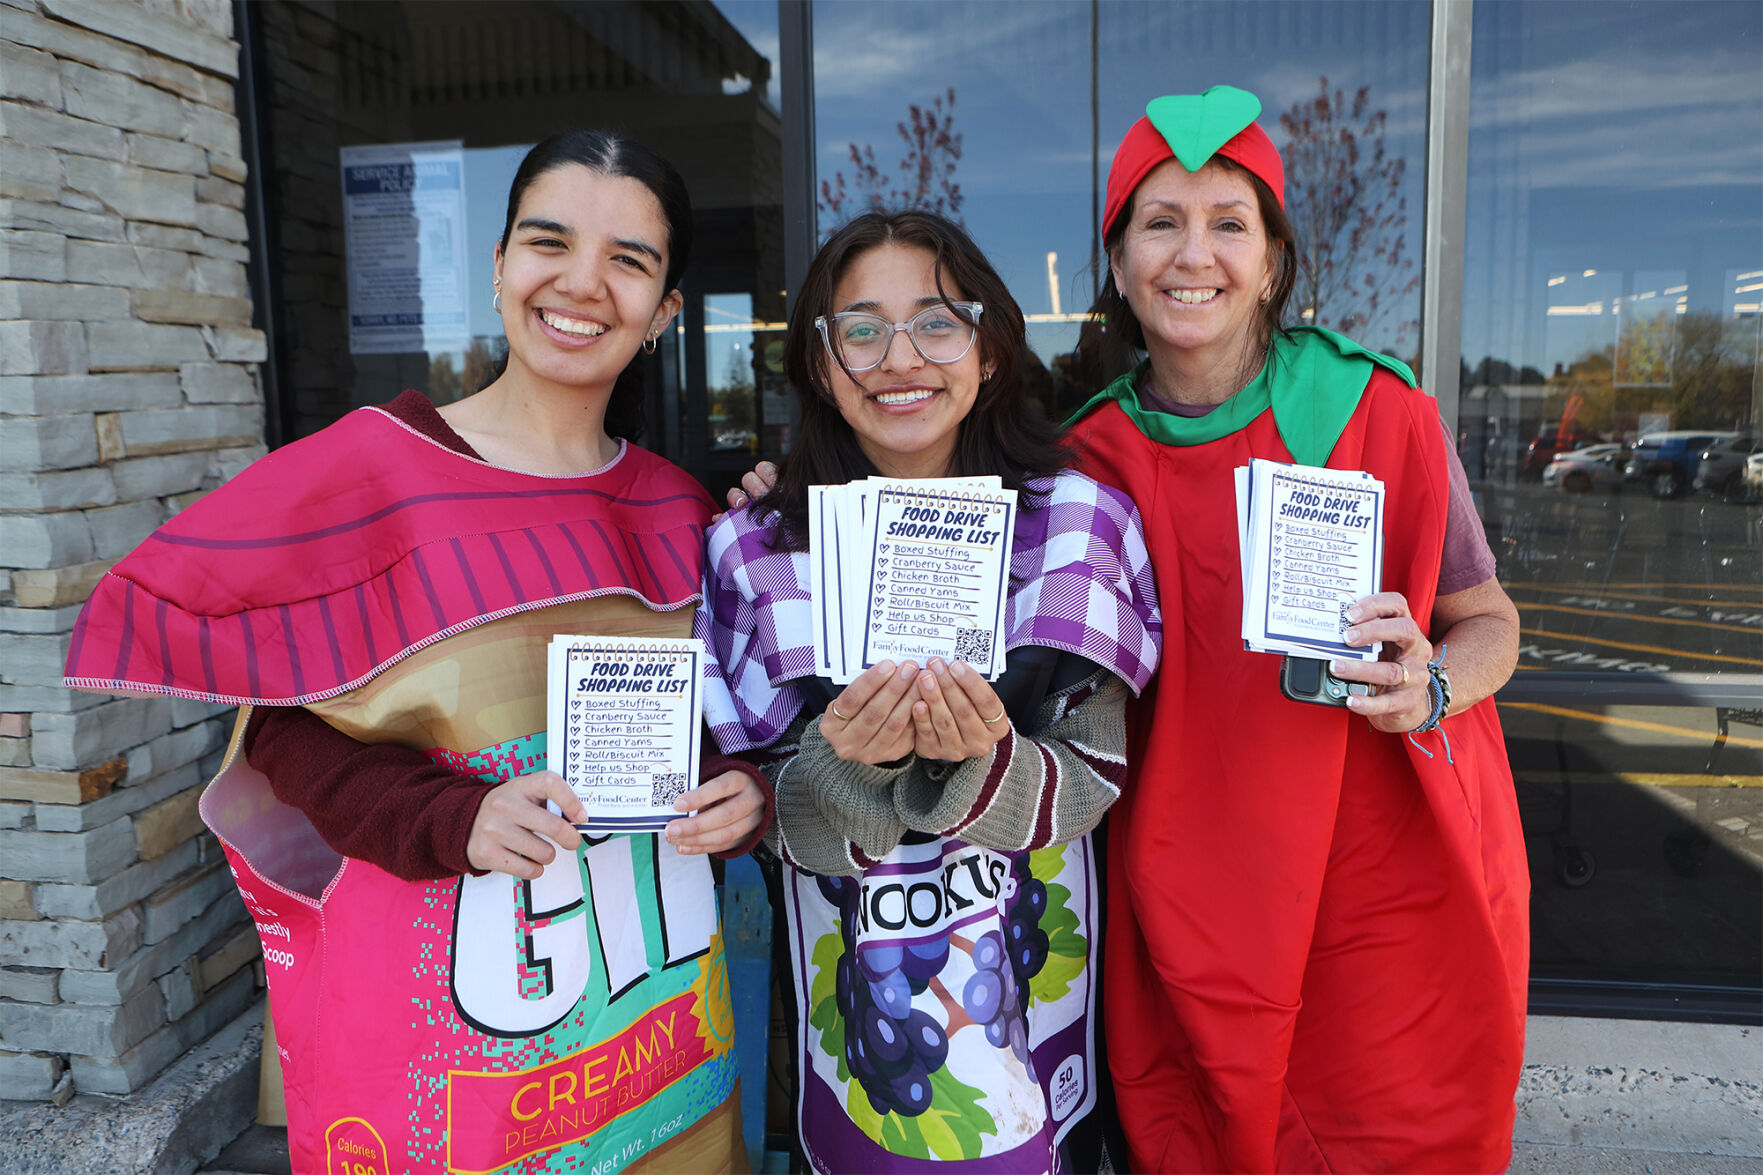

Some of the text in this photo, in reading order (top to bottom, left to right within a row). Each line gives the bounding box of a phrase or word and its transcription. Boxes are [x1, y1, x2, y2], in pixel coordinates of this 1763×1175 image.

[1290, 491, 1360, 513] FOOD DRIVE
[902, 507, 988, 527] FOOD DRIVE
[1280, 503, 1371, 529] SHOPPING LIST
[886, 521, 1000, 545] SHOPPING LIST
[1286, 524, 1347, 542] Boxed Stuffing
[1285, 535, 1352, 552] Cranberry Sauce
[894, 545, 970, 560] Boxed Stuffing
[1285, 547, 1339, 562] Chicken Broth
[893, 557, 975, 572] Cranberry Sauce
[1284, 560, 1339, 574] Canned Yams
[892, 571, 959, 583] Chicken Broth
[1284, 571, 1350, 587] Roll/Biscuit Mix
[890, 584, 958, 597] Canned Yams
[1283, 584, 1337, 598] Help us Shop
[890, 597, 971, 611] Roll/Biscuit Mix
[1283, 596, 1326, 609] Gift Cards
[888, 611, 910, 622] Help
[930, 614, 954, 625] Shop
[888, 623, 939, 635] Gift Cards
[591, 662, 676, 677] FOOD DRIVE
[577, 678, 689, 693] SHOPPING LIST
[586, 698, 661, 711] Boxed Stuffing
[585, 712, 667, 724] Cranberry Sauce
[585, 725, 653, 734] Chicken Broth
[585, 738, 652, 747] Canned Yams
[585, 749, 664, 759] Roll/Biscuit Mix
[584, 764, 606, 773] Help
[625, 764, 650, 773] Shop
[584, 775, 636, 786] Gift Cards
[256, 921, 291, 943] nestly
[261, 941, 295, 971] Scoop
[510, 1010, 677, 1122] CREAMY
[1058, 1065, 1074, 1090] 50
[1055, 1079, 1079, 1105] Calories
[504, 1050, 687, 1155] PEANUT BUTTER
[337, 1137, 377, 1160] Calories
[590, 1113, 684, 1175] Net Wt. 16oz
